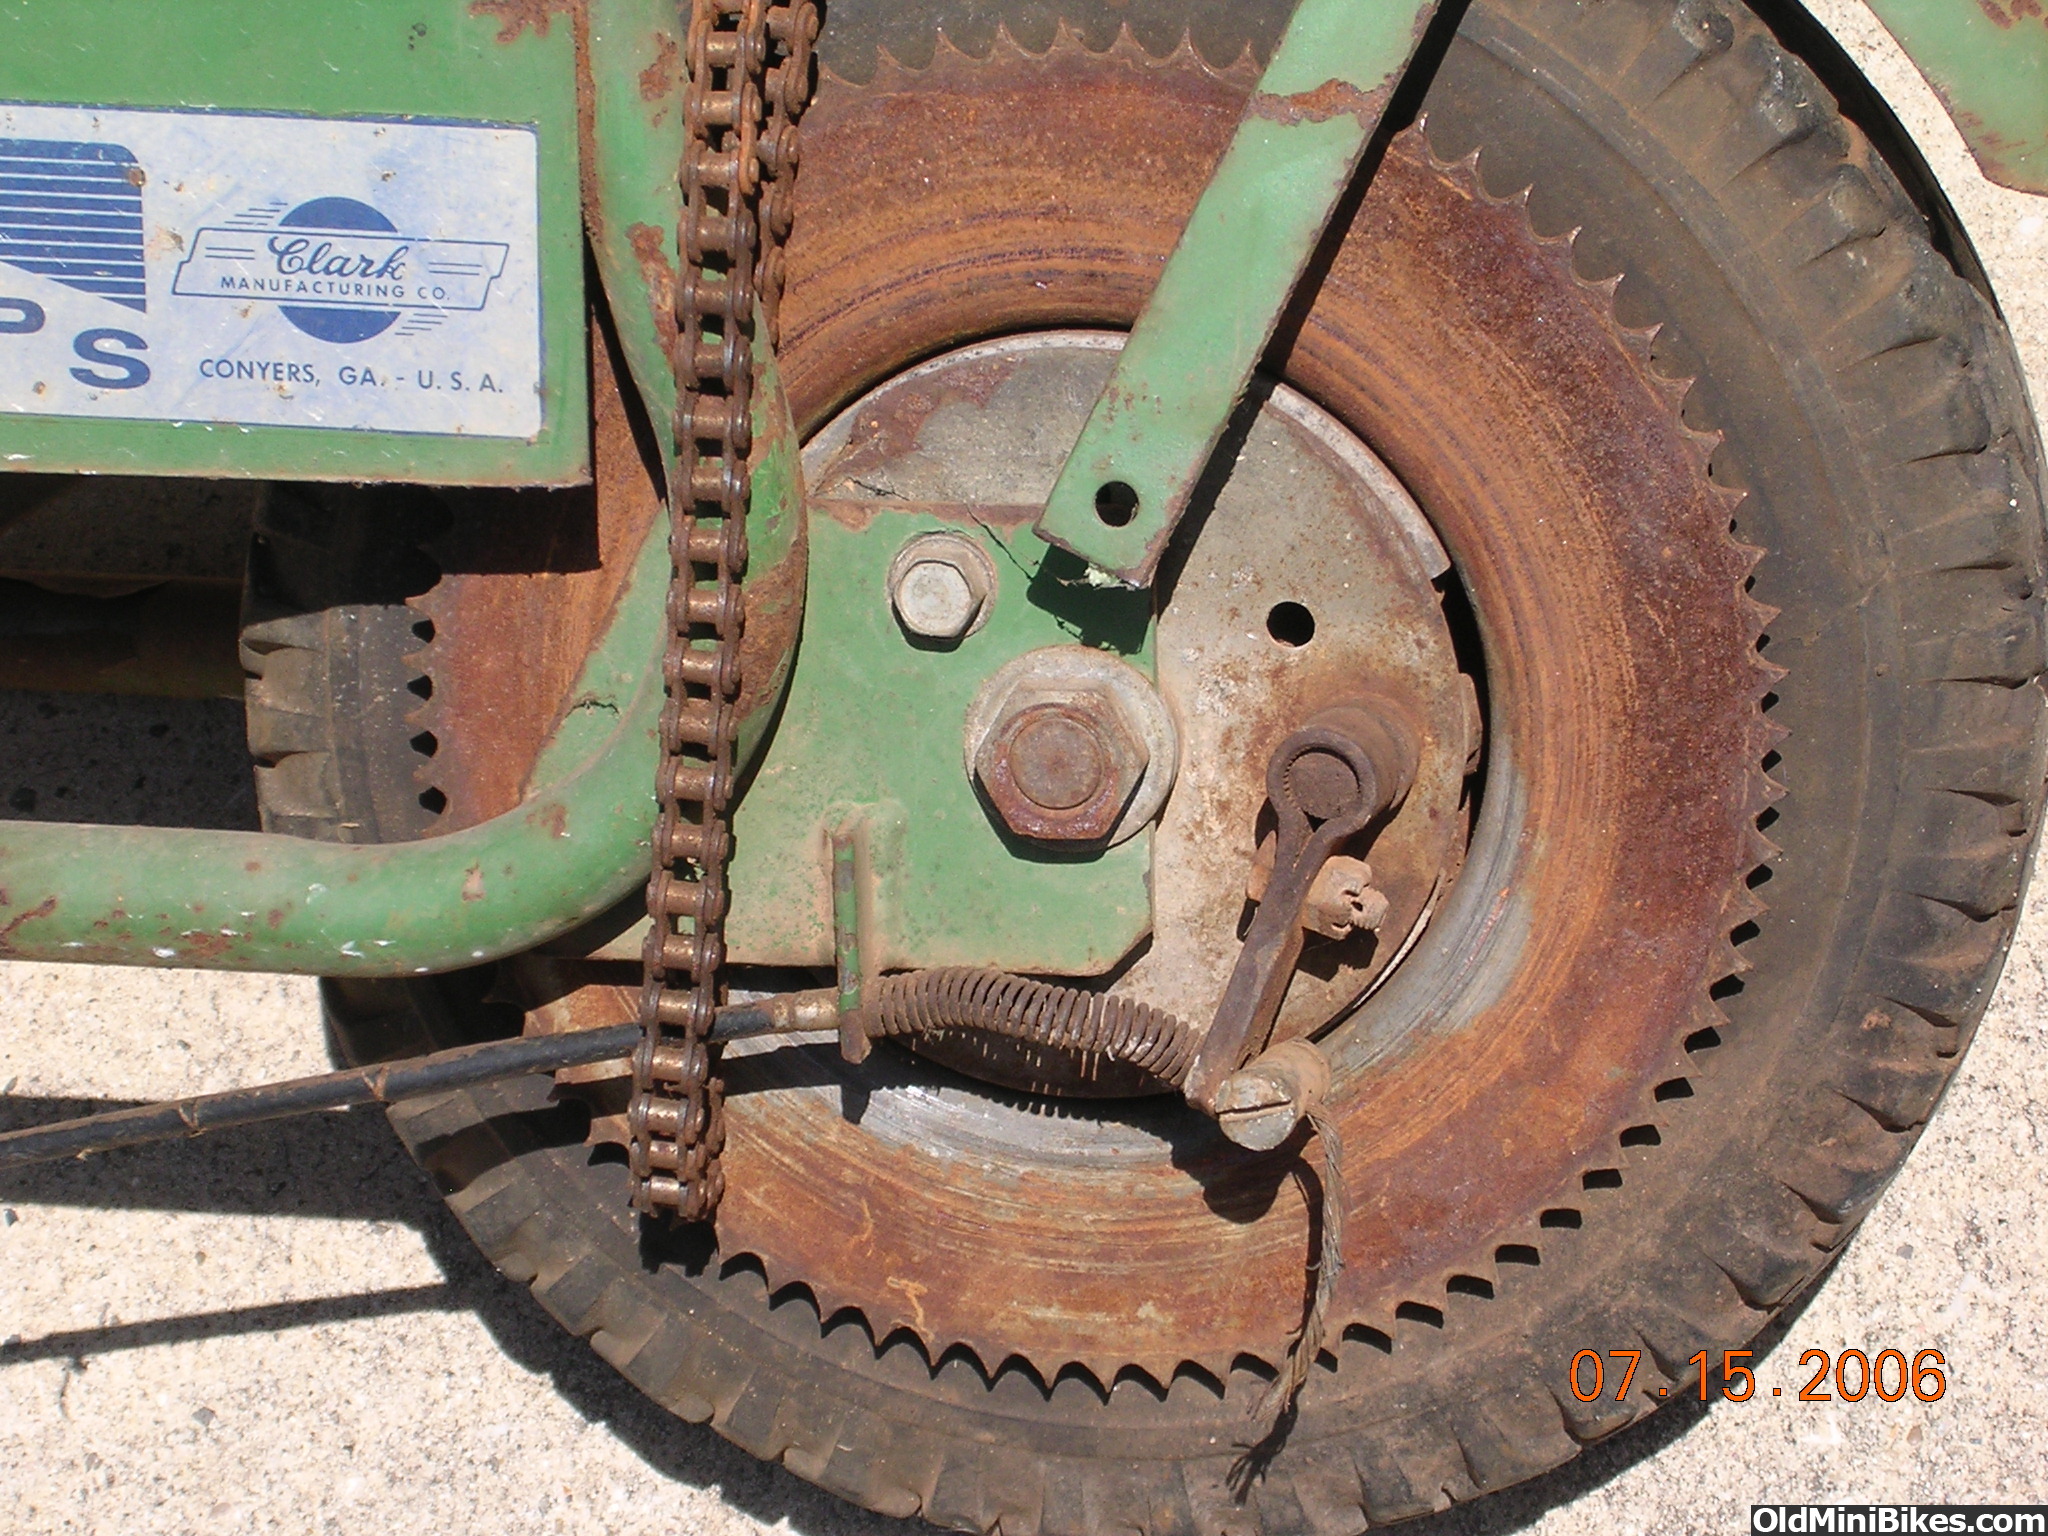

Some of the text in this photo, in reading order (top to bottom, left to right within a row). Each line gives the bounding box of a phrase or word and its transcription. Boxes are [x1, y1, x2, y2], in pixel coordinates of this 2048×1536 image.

[268, 236, 409, 281] Clark
[221, 276, 450, 300] MANUFACTURING CO.
[200, 359, 320, 387] CONYERS,
[339, 366, 384, 386] GA.
